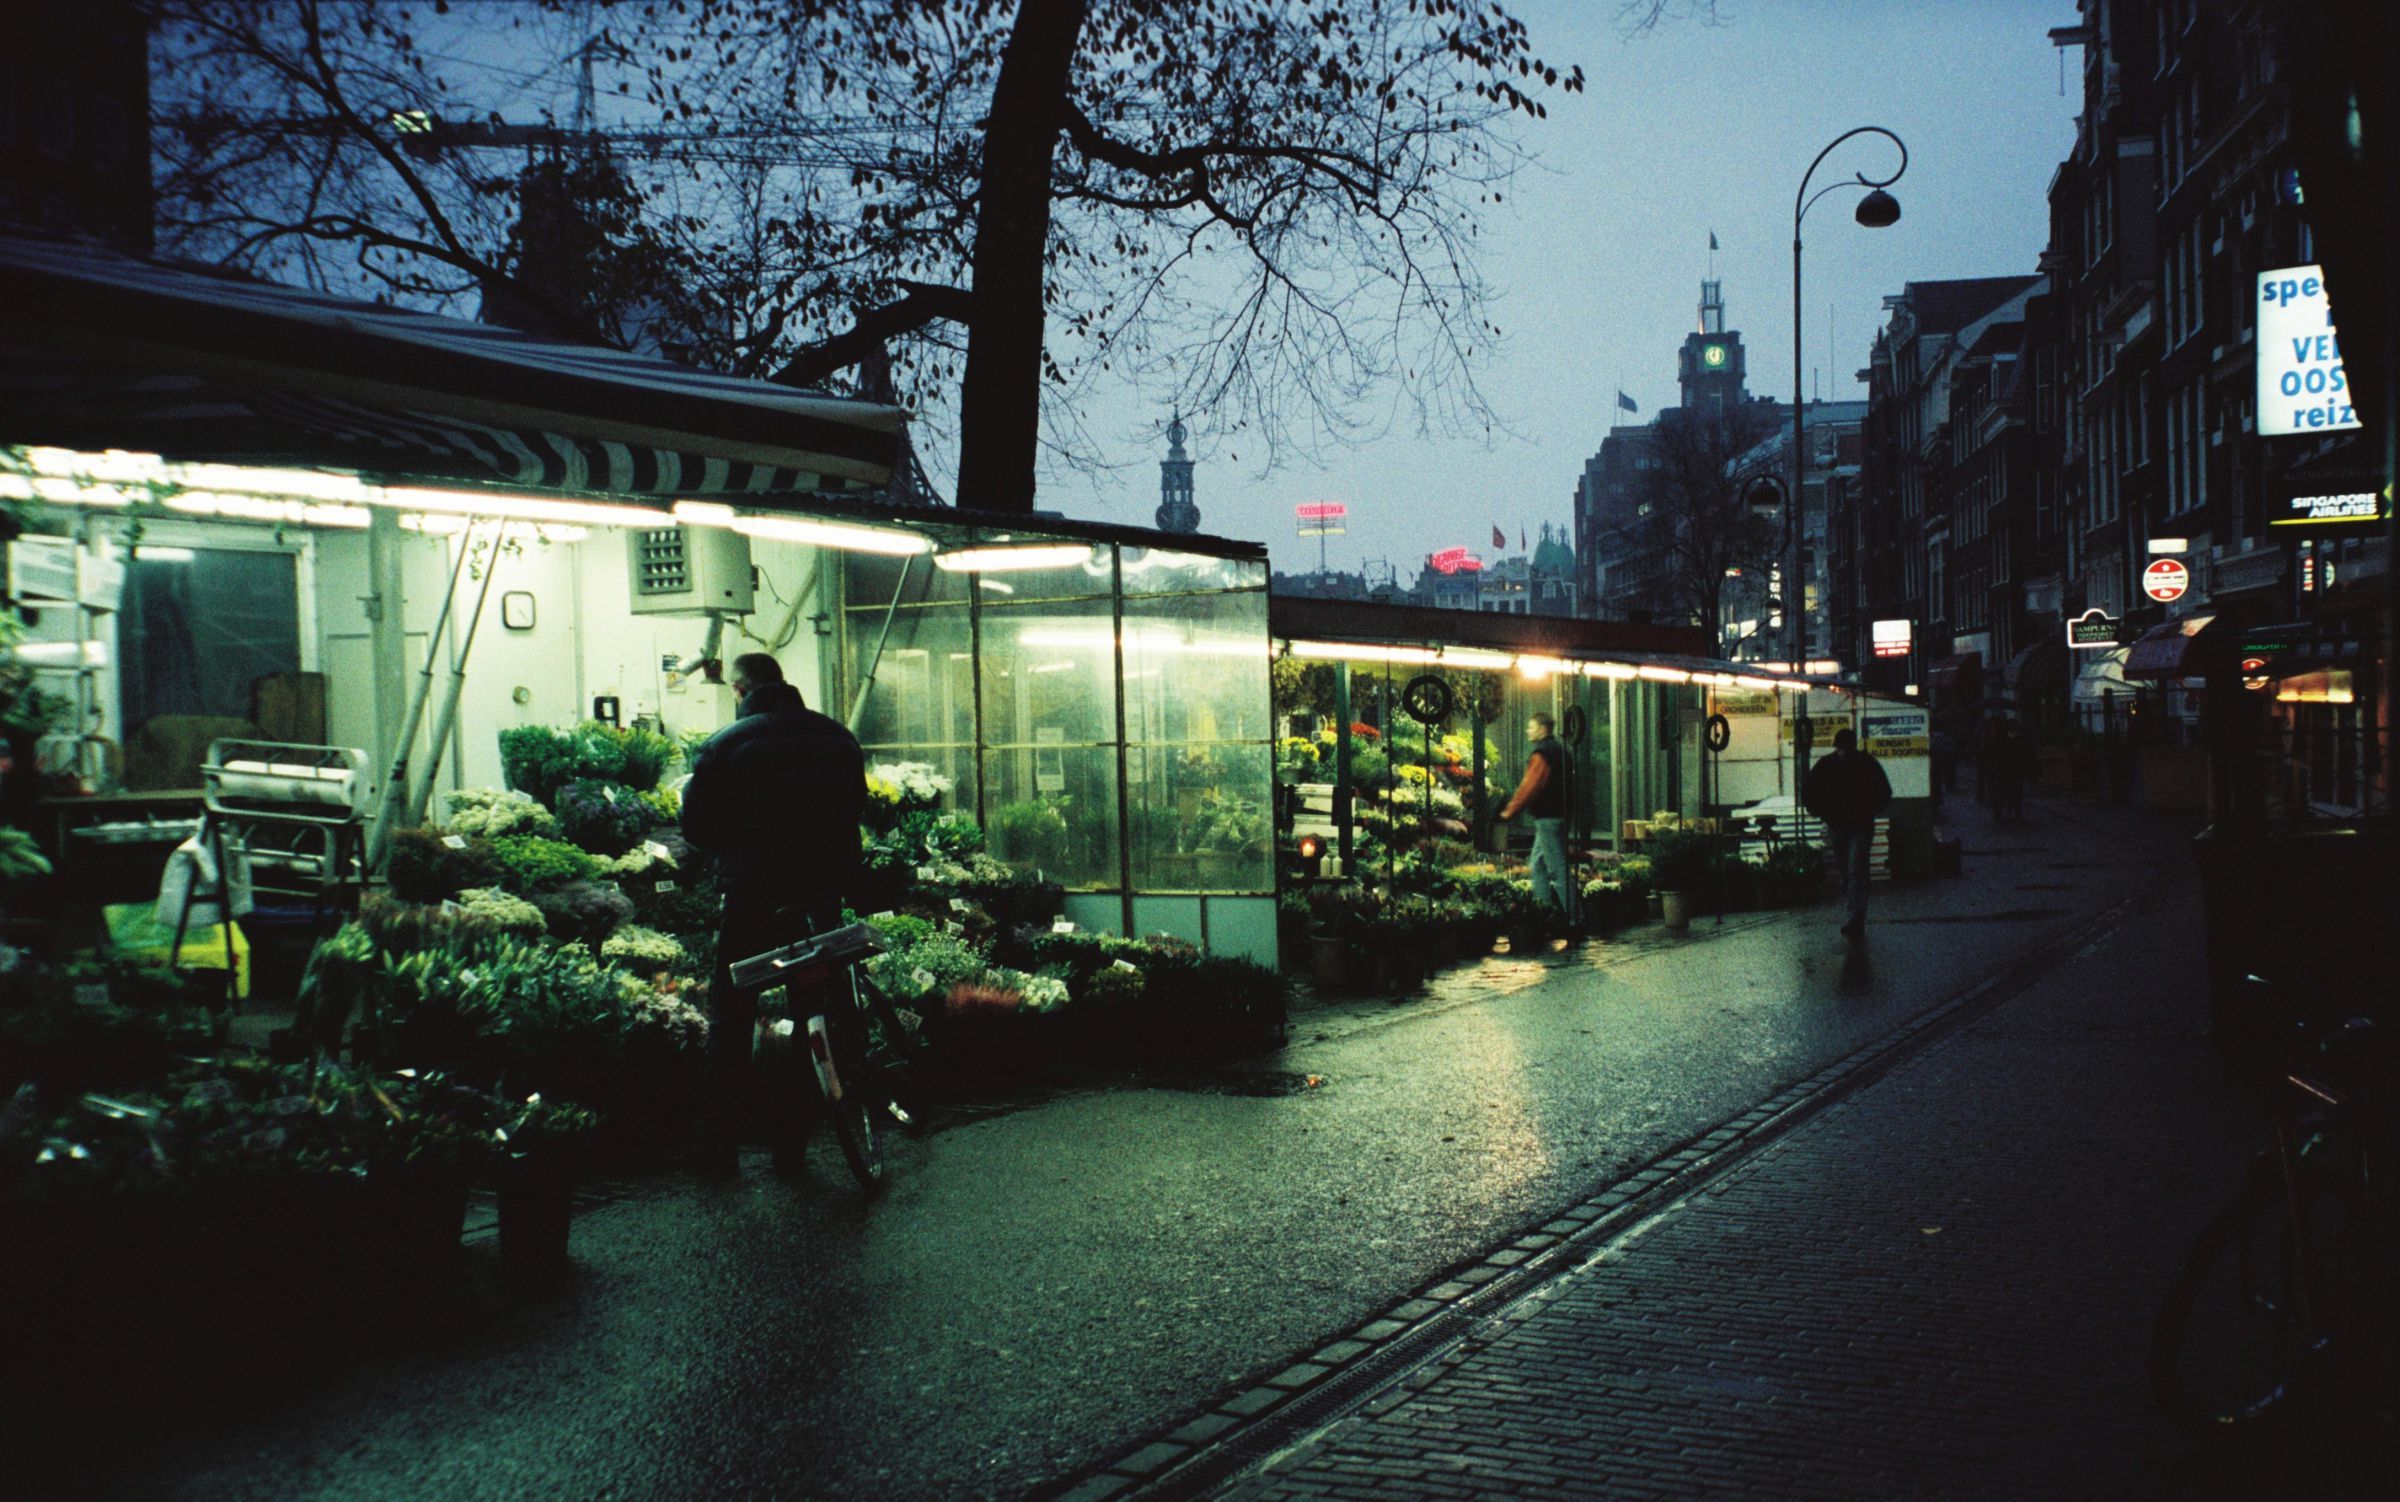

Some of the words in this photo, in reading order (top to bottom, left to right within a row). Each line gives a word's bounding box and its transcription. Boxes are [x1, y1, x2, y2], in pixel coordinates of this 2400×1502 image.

[2262, 277, 2320, 307] spe
[2280, 365, 2345, 397] OOS
[2294, 398, 2354, 428] reiz
[2291, 493, 2378, 509] SINGAPORE
[2308, 503, 2378, 518] AIRLINES
